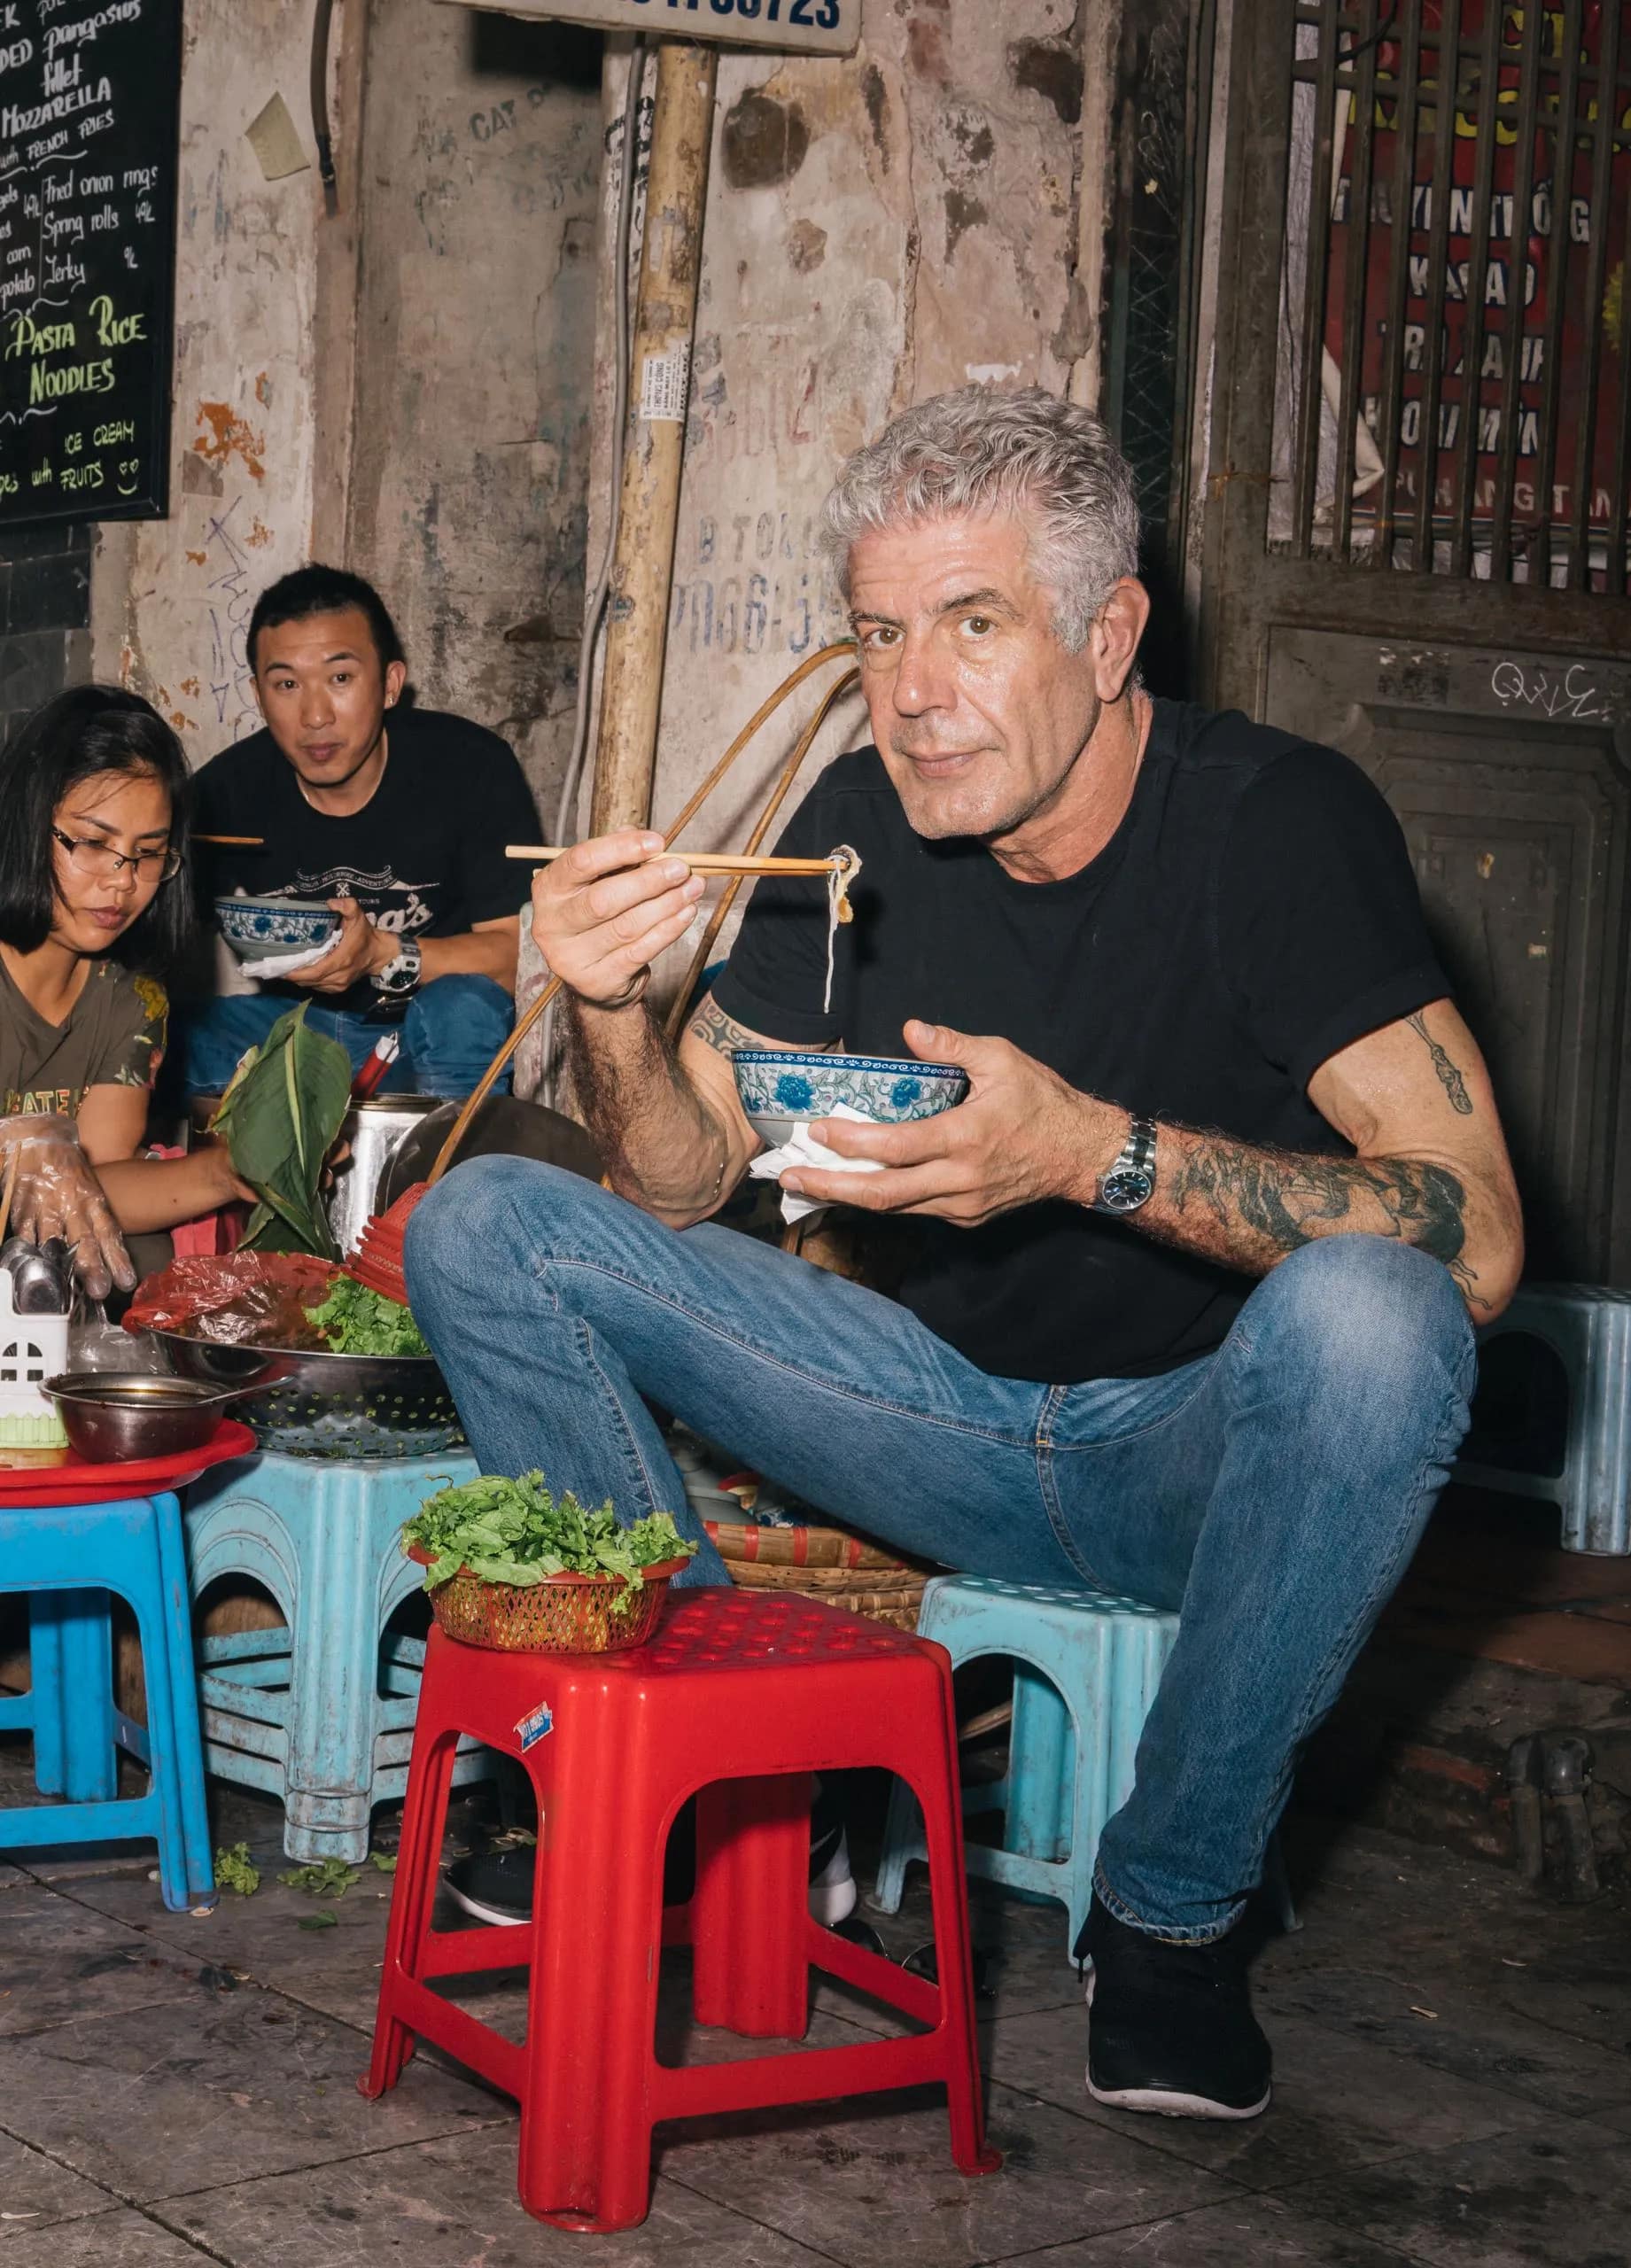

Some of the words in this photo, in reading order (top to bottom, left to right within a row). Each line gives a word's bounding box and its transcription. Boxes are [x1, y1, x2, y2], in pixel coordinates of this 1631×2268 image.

[80, 175, 113, 196] onion
[91, 204, 120, 231] rolls
[60, 460, 105, 491] FRUITS
